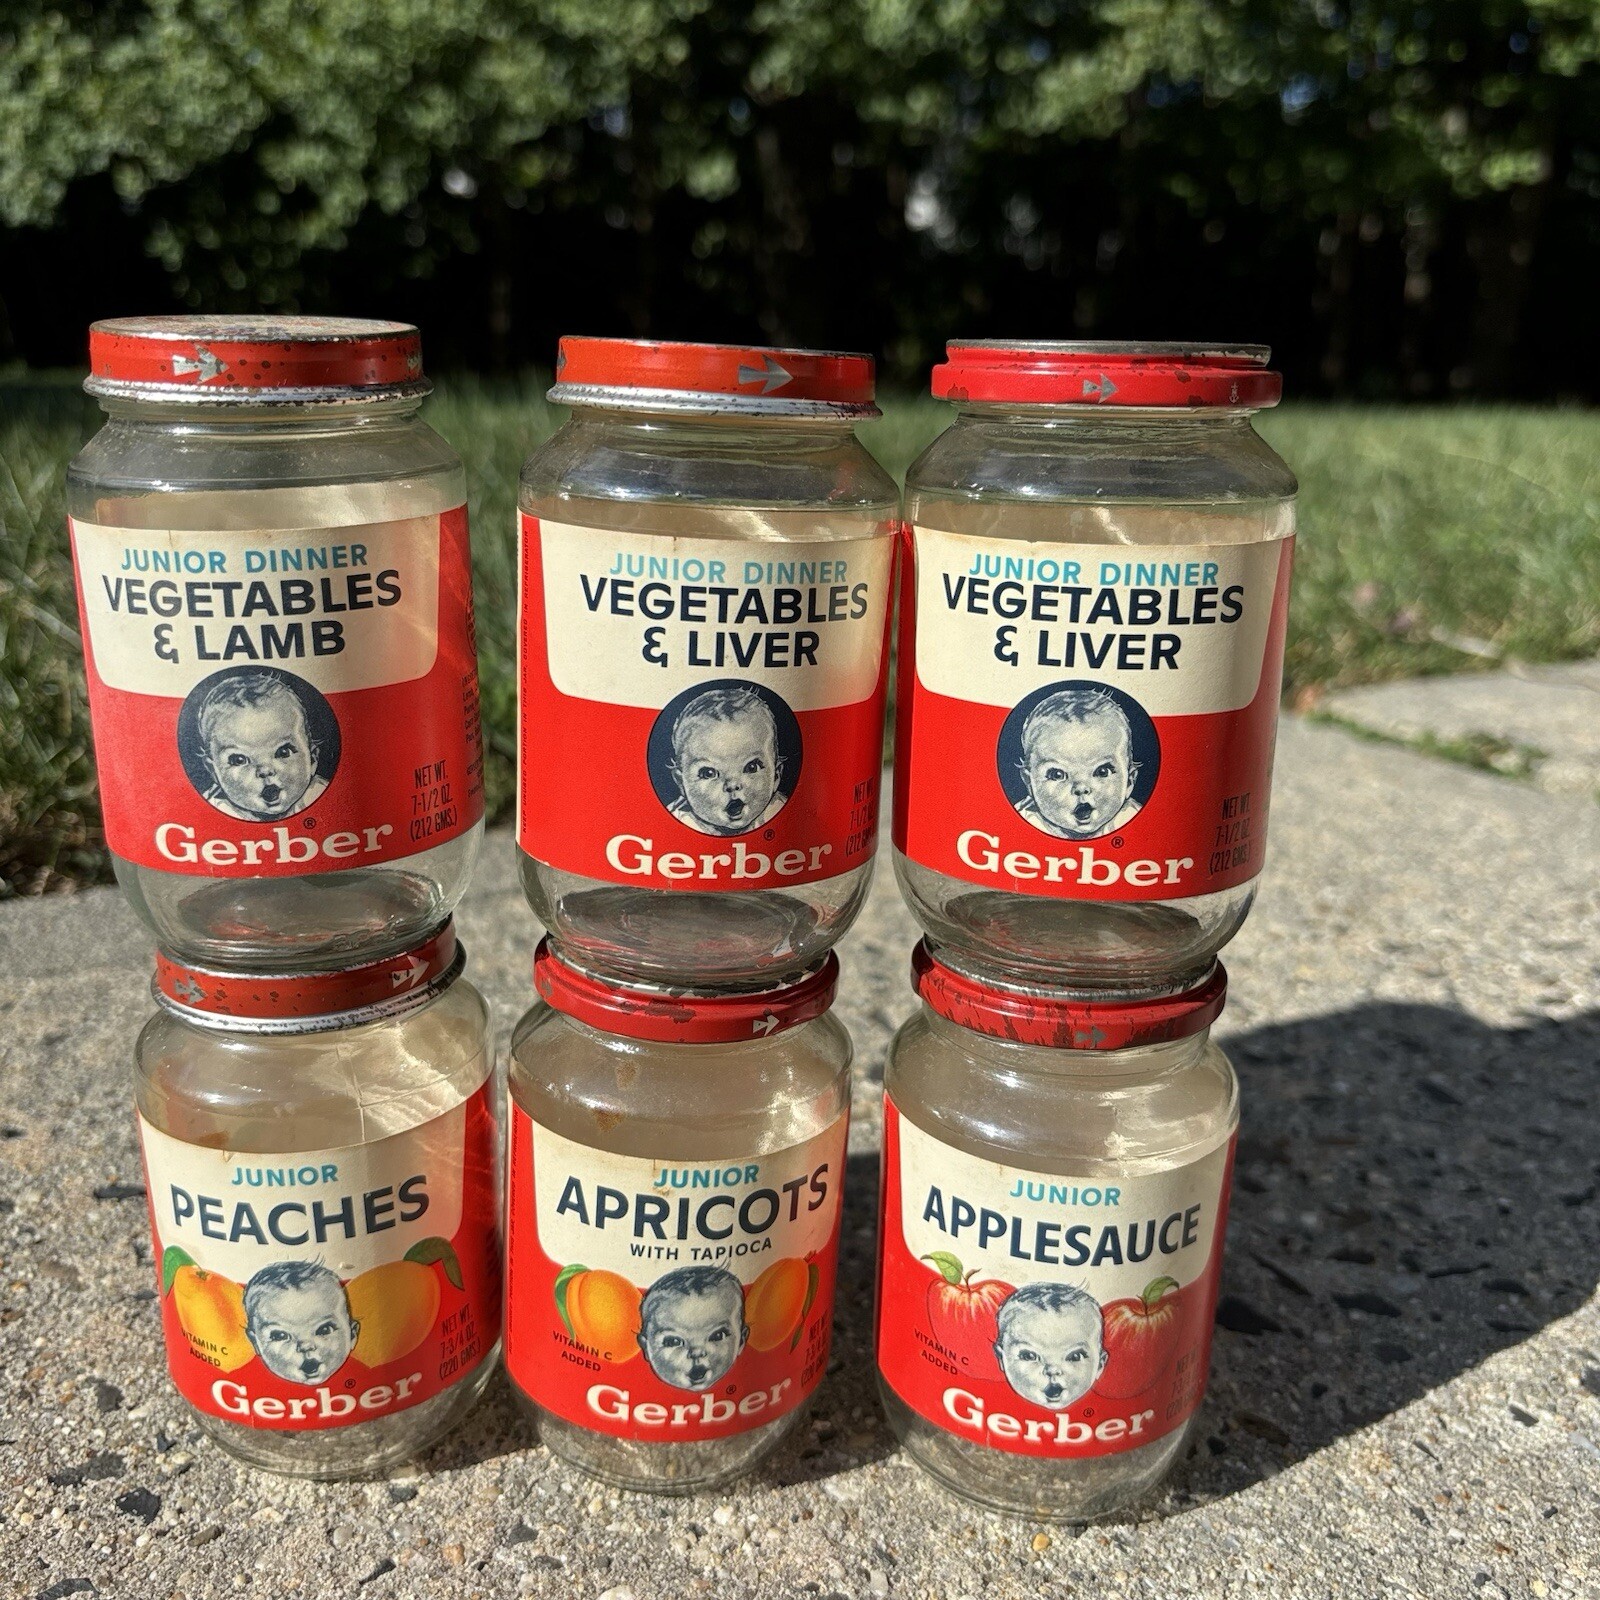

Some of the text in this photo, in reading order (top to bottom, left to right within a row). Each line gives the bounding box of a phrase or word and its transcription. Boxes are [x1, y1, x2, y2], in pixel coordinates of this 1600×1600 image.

[121, 544, 368, 574] JUNIOR DINNER
[609, 553, 848, 585] JUNIOR DINNER
[969, 553, 1219, 587] JUNIOR DINNER
[102, 569, 402, 619] VEGETABLES
[580, 573, 868, 625] VEGETABLES
[942, 573, 1245, 627] VEGETABLES
[154, 620, 346, 664] & LAMB
[642, 626, 820, 669] & LIVER
[994, 625, 1182, 671] & LIVER
[415, 765, 431, 789] NET
[411, 788, 439, 815] 7-1/2
[1222, 796, 1239, 820] NET
[154, 822, 394, 866] Gerber
[410, 816, 432, 842] (212
[605, 833, 832, 880] Gerber
[956, 829, 1194, 886] Gerber
[231, 1164, 338, 1188] JUNIOR
[654, 1164, 760, 1189] JUNIOR
[1010, 1179, 1121, 1206] JUNIOR
[170, 1174, 430, 1246] PEACHES
[556, 1163, 829, 1241] APRICOTS
[922, 1184, 1201, 1267] APPLESAUCE
[630, 1237, 772, 1261] WITH TAPIOCA
[181, 1327, 228, 1355] VITAMIN C
[442, 1312, 457, 1337] NET
[189, 1347, 221, 1367] ADDED
[552, 1330, 613, 1361] VITAMIN C
[561, 1350, 602, 1372] ADDED
[914, 1328, 970, 1366] VITAMIN C
[921, 1349, 958, 1375] ADDED
[440, 1354, 459, 1381] (220
[211, 1372, 423, 1419] Gerber
[587, 1378, 792, 1426] Gerber
[942, 1387, 1154, 1444] Gerber
